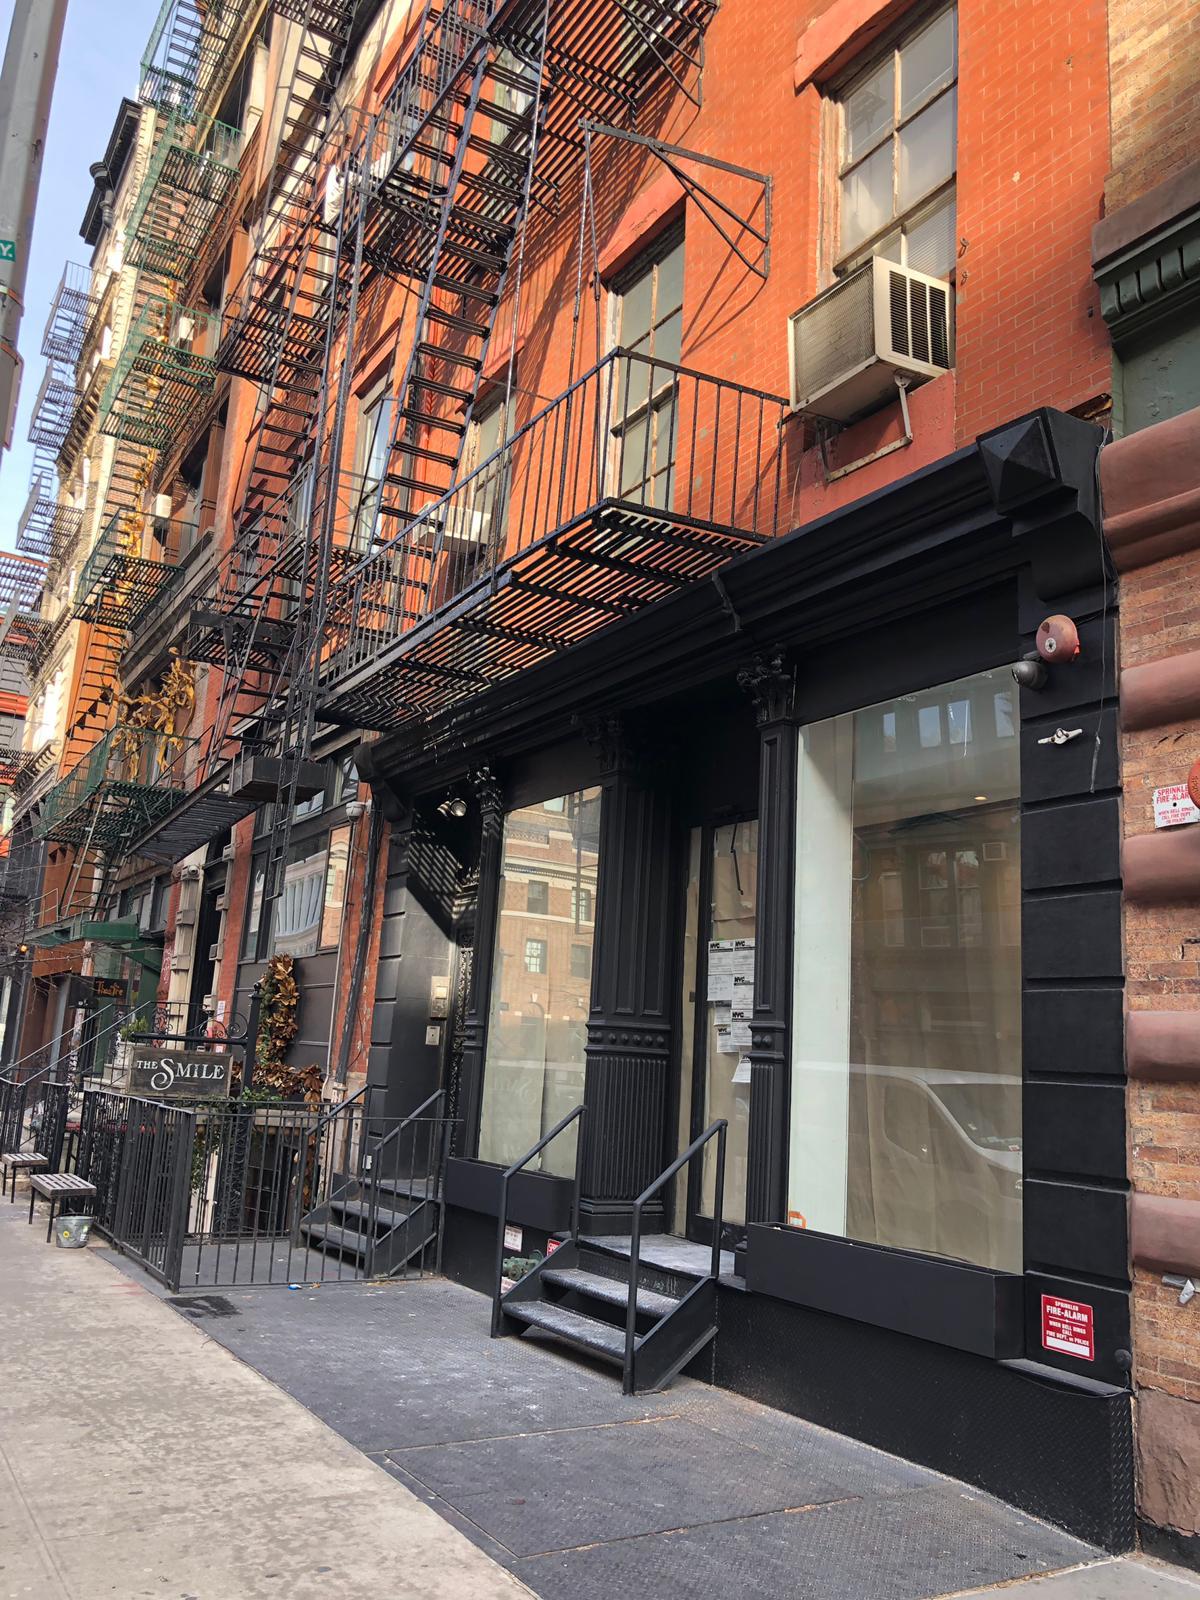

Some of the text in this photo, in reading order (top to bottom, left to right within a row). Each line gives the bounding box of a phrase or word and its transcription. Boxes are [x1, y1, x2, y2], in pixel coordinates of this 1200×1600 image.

[1157, 785, 1188, 796] SPRINKLE
[1156, 792, 1190, 804] FIRE-ALAR
[137, 1058, 224, 1090] THE SMILE
[1055, 1301, 1079, 1311] SPRINKLER
[1046, 1305, 1088, 1322] FIRE-ALARM
